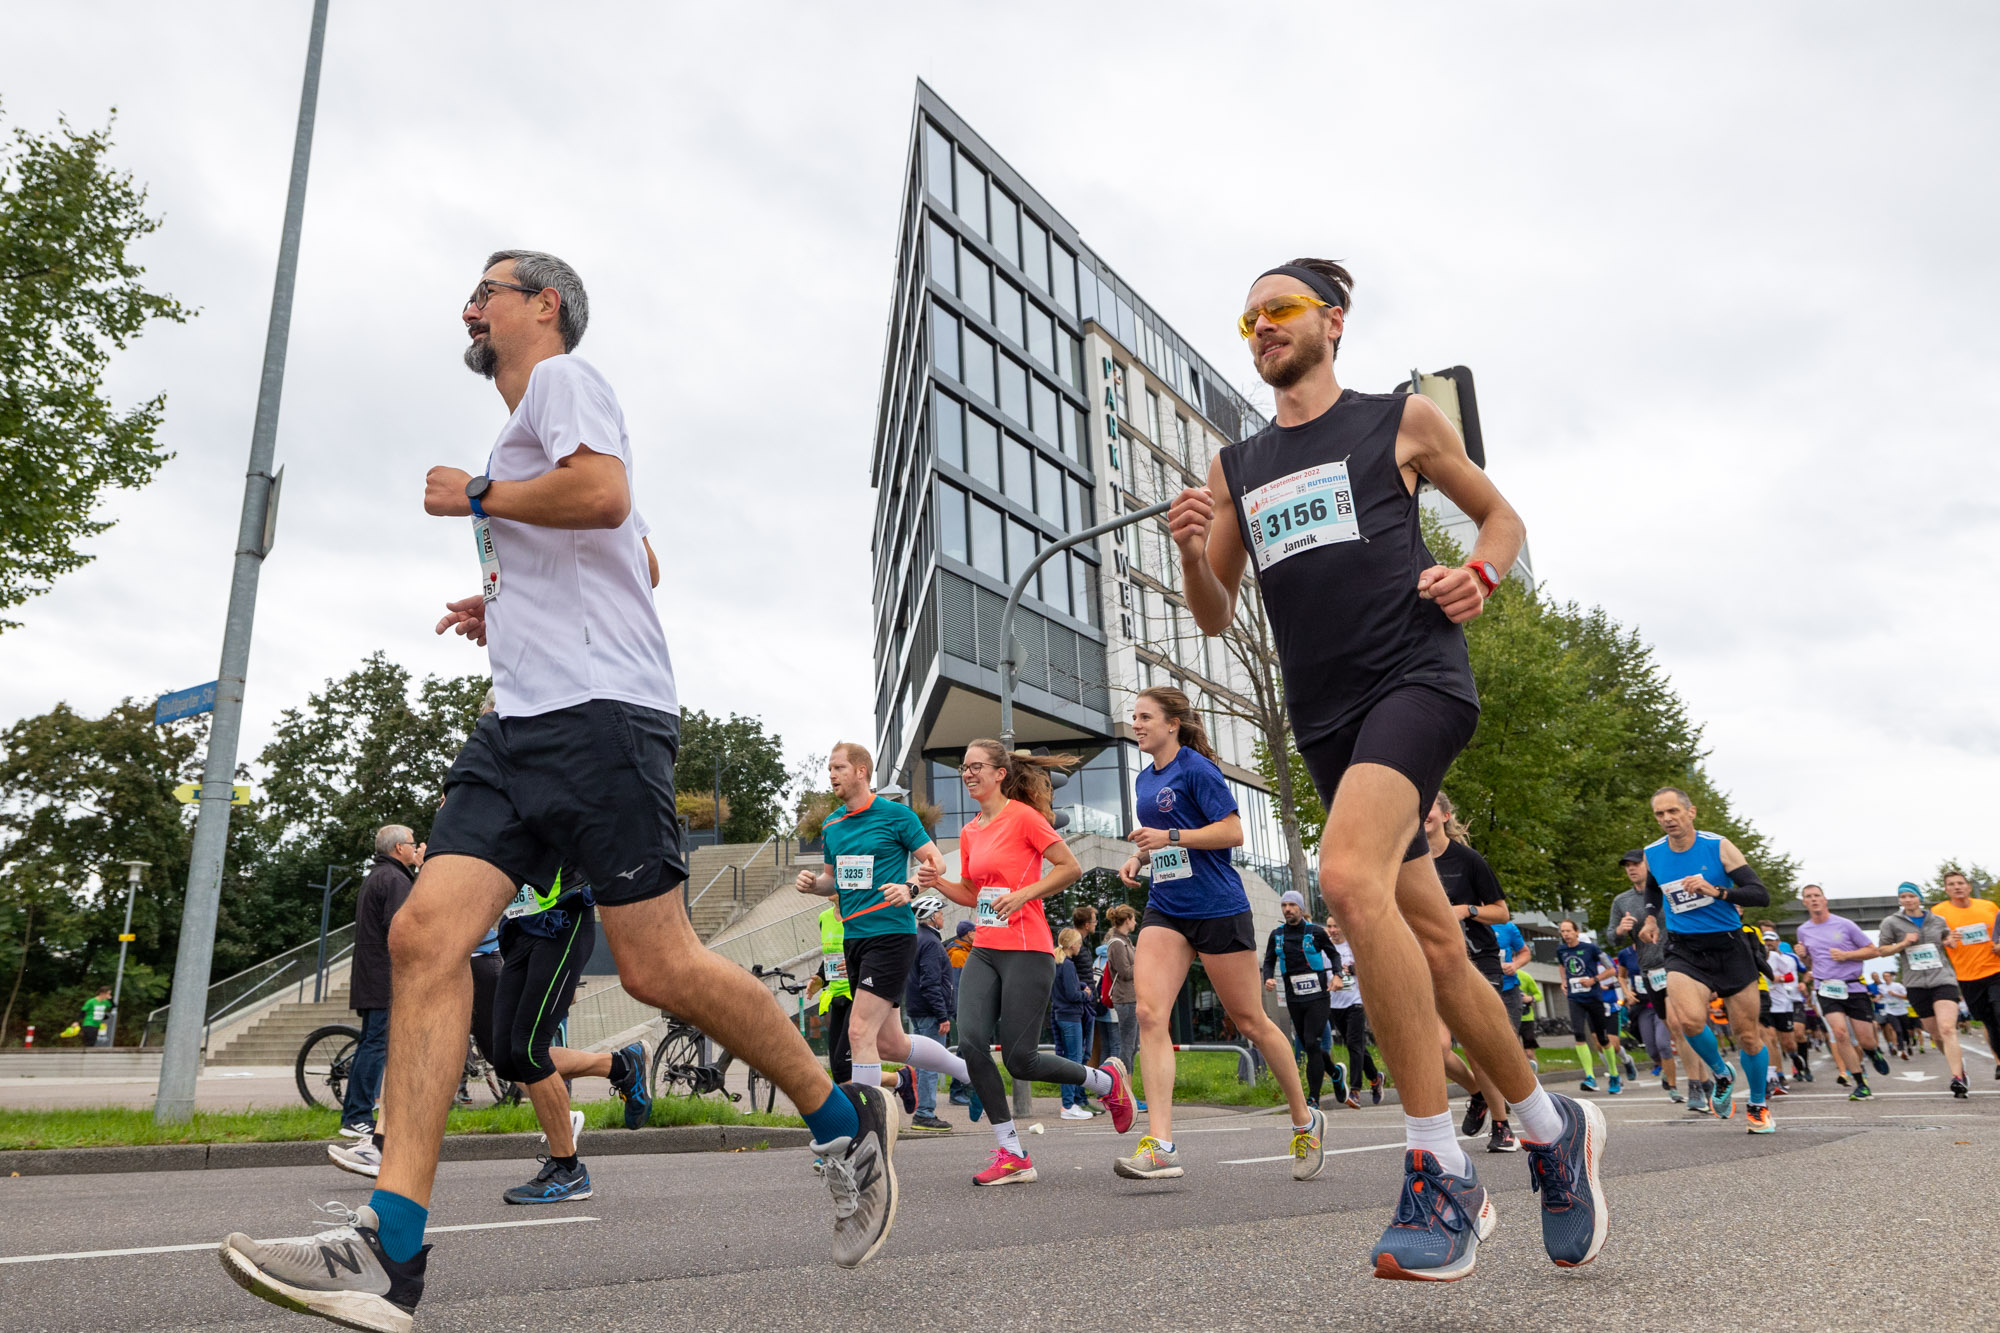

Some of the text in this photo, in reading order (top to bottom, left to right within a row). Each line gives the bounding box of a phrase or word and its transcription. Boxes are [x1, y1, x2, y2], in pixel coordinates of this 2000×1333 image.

[1269, 474, 1302, 490] September
[1304, 468, 1321, 478] 2022
[1307, 474, 1348, 488] RUTRONIK
[1102, 356, 1133, 640] PARK TOWER
[1266, 498, 1328, 538] 3156
[1283, 534, 1318, 554] Jannik
[1155, 853, 1178, 869] 1703
[844, 869, 864, 879] 3235
[1299, 981, 1313, 989] 773
